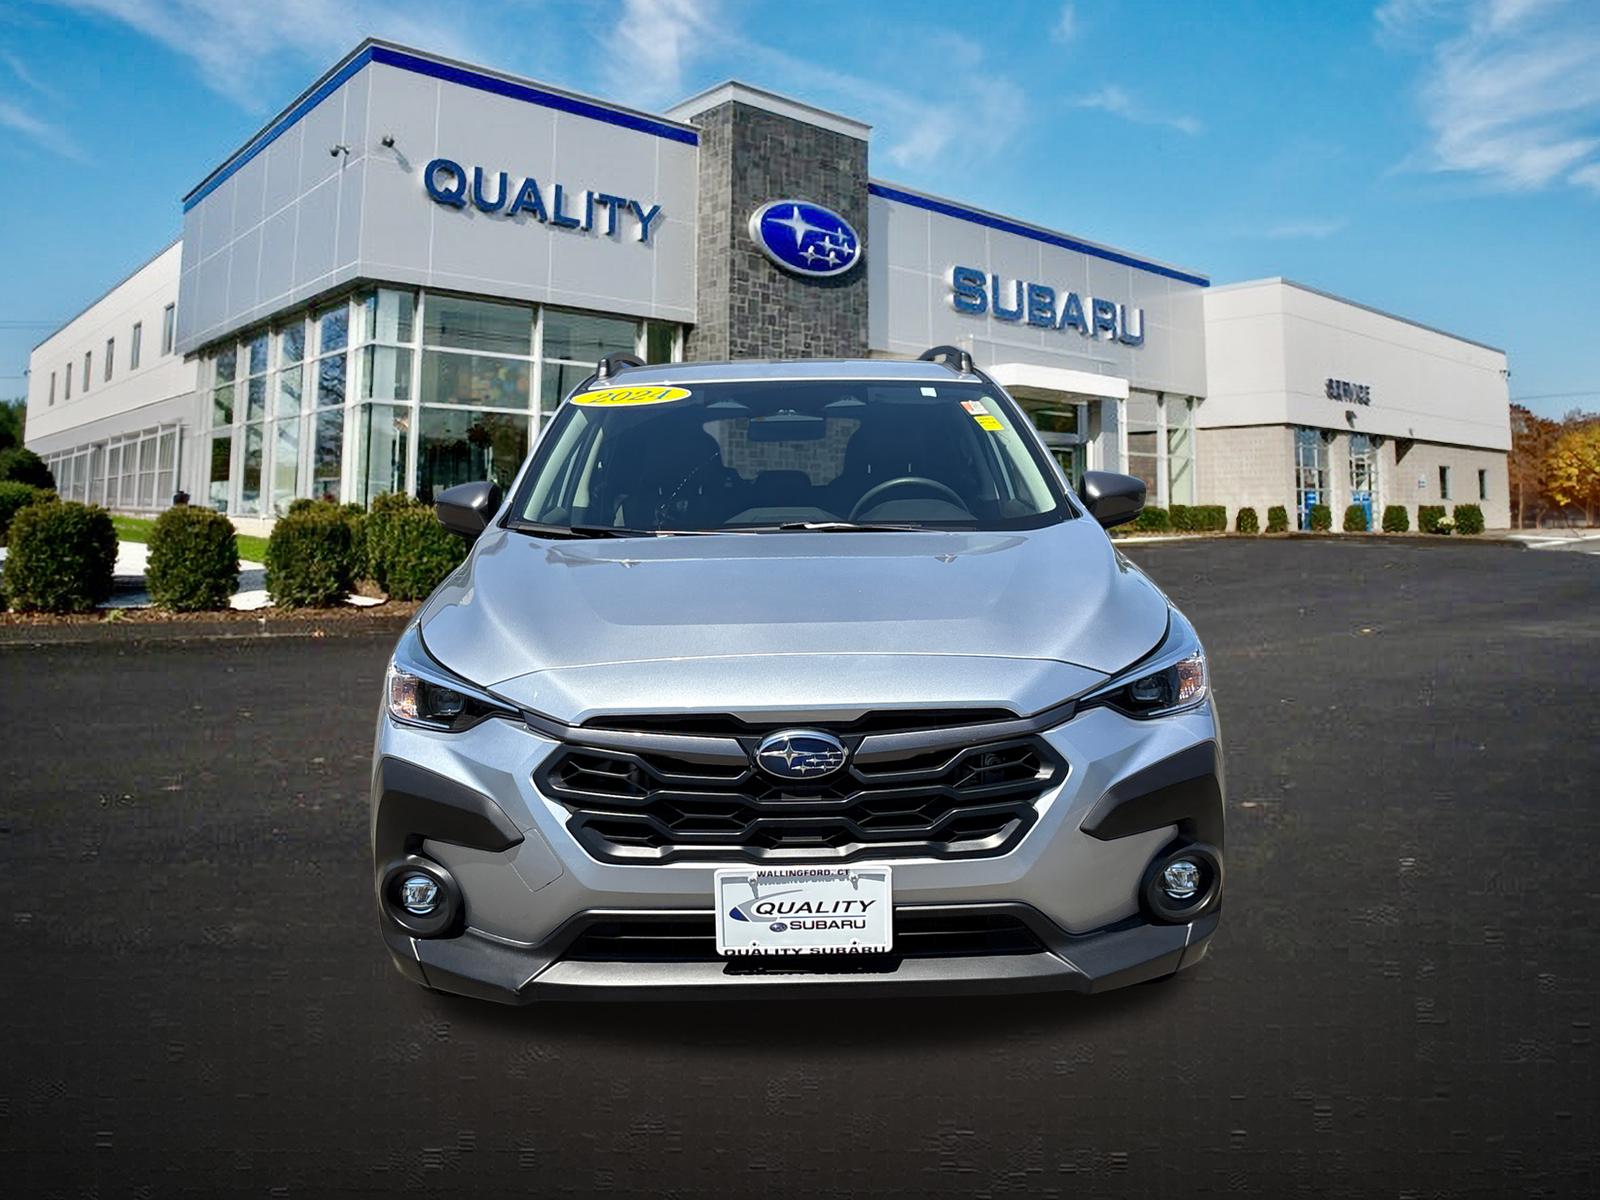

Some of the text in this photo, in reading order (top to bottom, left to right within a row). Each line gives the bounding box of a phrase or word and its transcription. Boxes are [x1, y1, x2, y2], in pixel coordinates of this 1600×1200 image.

[424, 158, 662, 243] QUALITY
[950, 265, 1144, 347] SUBARU
[589, 389, 672, 403] 2024
[837, 868, 849, 876] CT
[755, 899, 876, 916] QUALITY
[790, 919, 866, 931] SUBARU
[724, 945, 886, 956] QUALITY SUBARU
